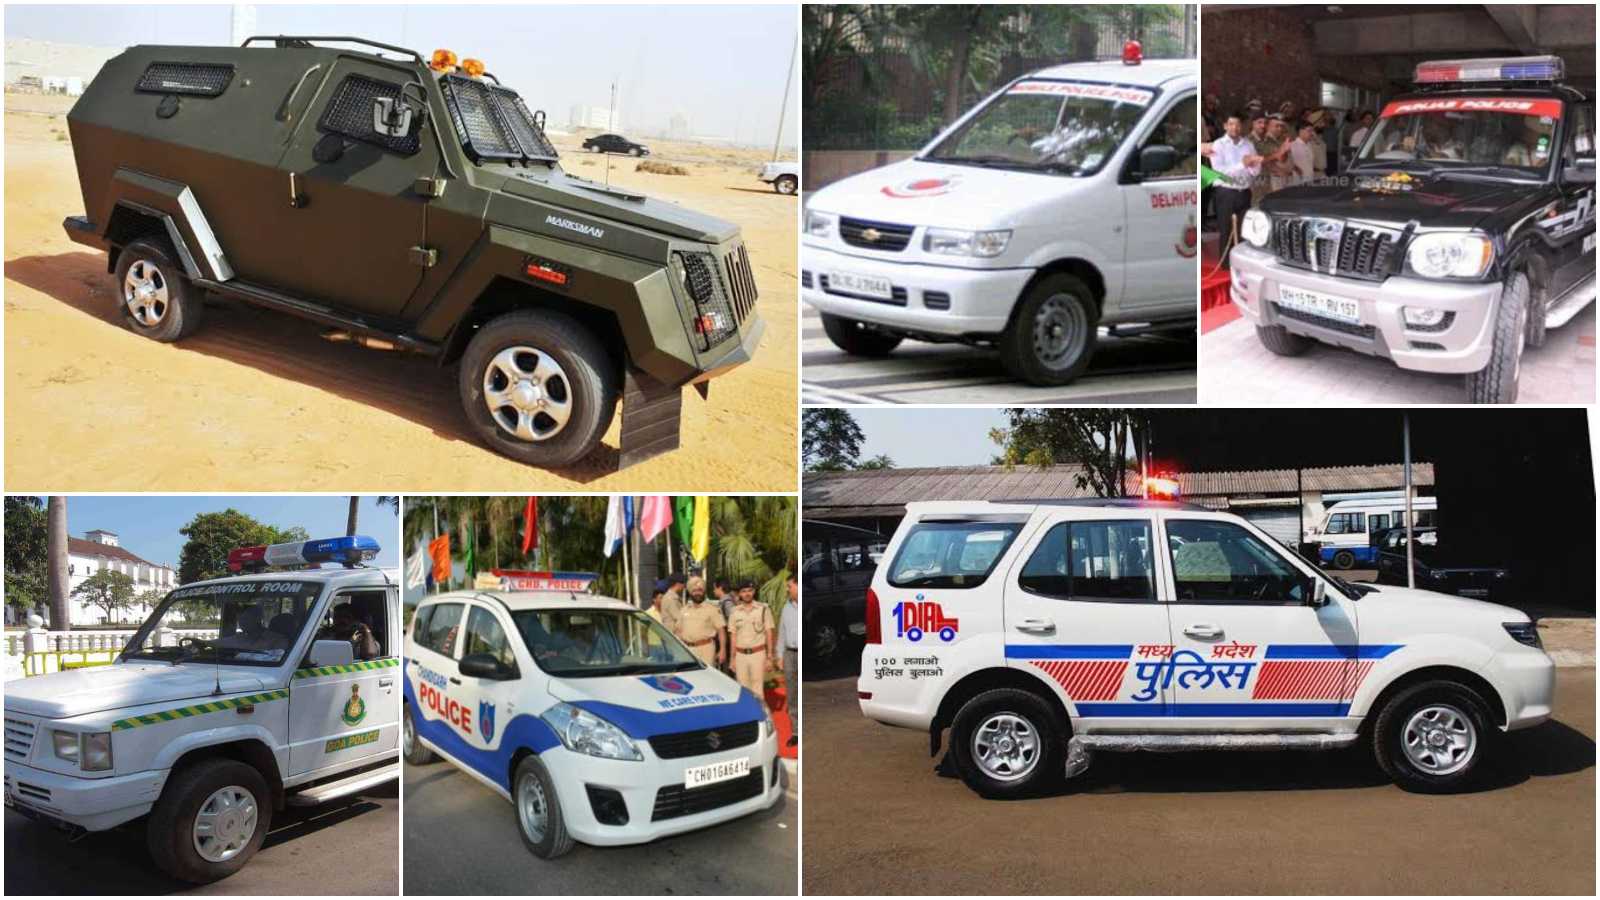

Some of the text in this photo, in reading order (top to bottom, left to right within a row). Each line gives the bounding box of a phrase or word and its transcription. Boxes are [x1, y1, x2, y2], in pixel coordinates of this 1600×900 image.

[1057, 85, 1105, 97] POLICE
[1460, 101, 1534, 110] POLICE
[545, 215, 604, 238] MARKSMAN
[206, 583, 256, 595] CONTROL
[261, 583, 303, 593] ROOM
[547, 580, 583, 590] POLICE
[1138, 640, 1257, 658] मध्य प्रदेश
[1131, 650, 1256, 702] पुलिस
[420, 682, 472, 734] POLICE
